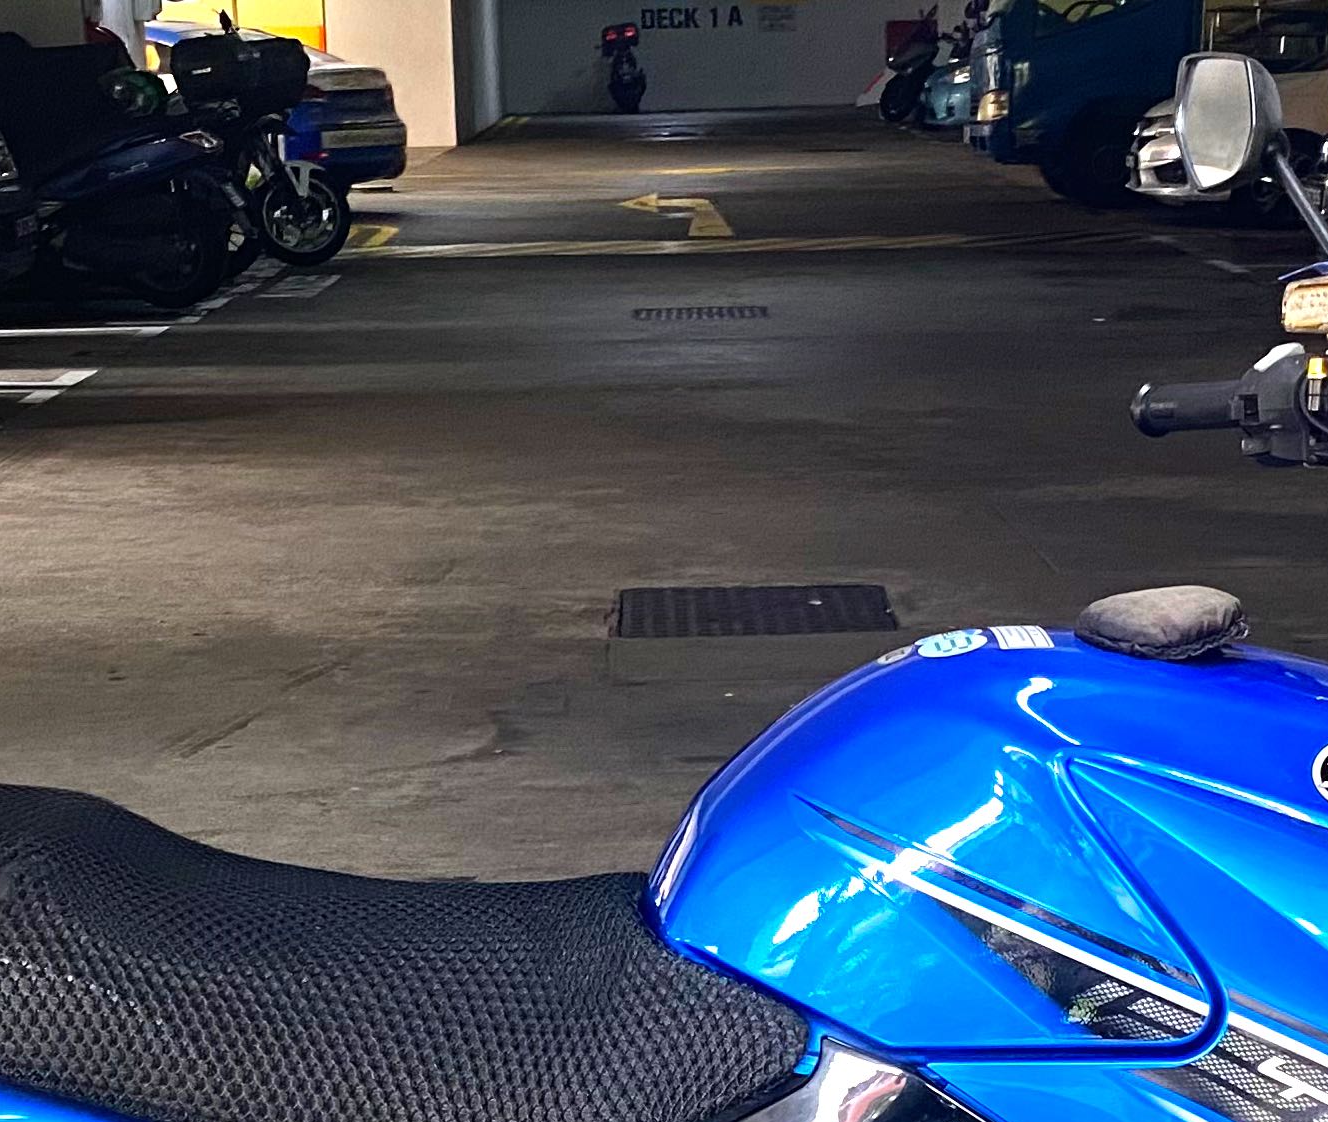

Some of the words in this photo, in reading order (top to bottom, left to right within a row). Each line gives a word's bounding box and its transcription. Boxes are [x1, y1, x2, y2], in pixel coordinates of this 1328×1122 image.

[640, 8, 700, 30] DECK
[709, 7, 718, 28] 1
[727, 5, 743, 27] A
